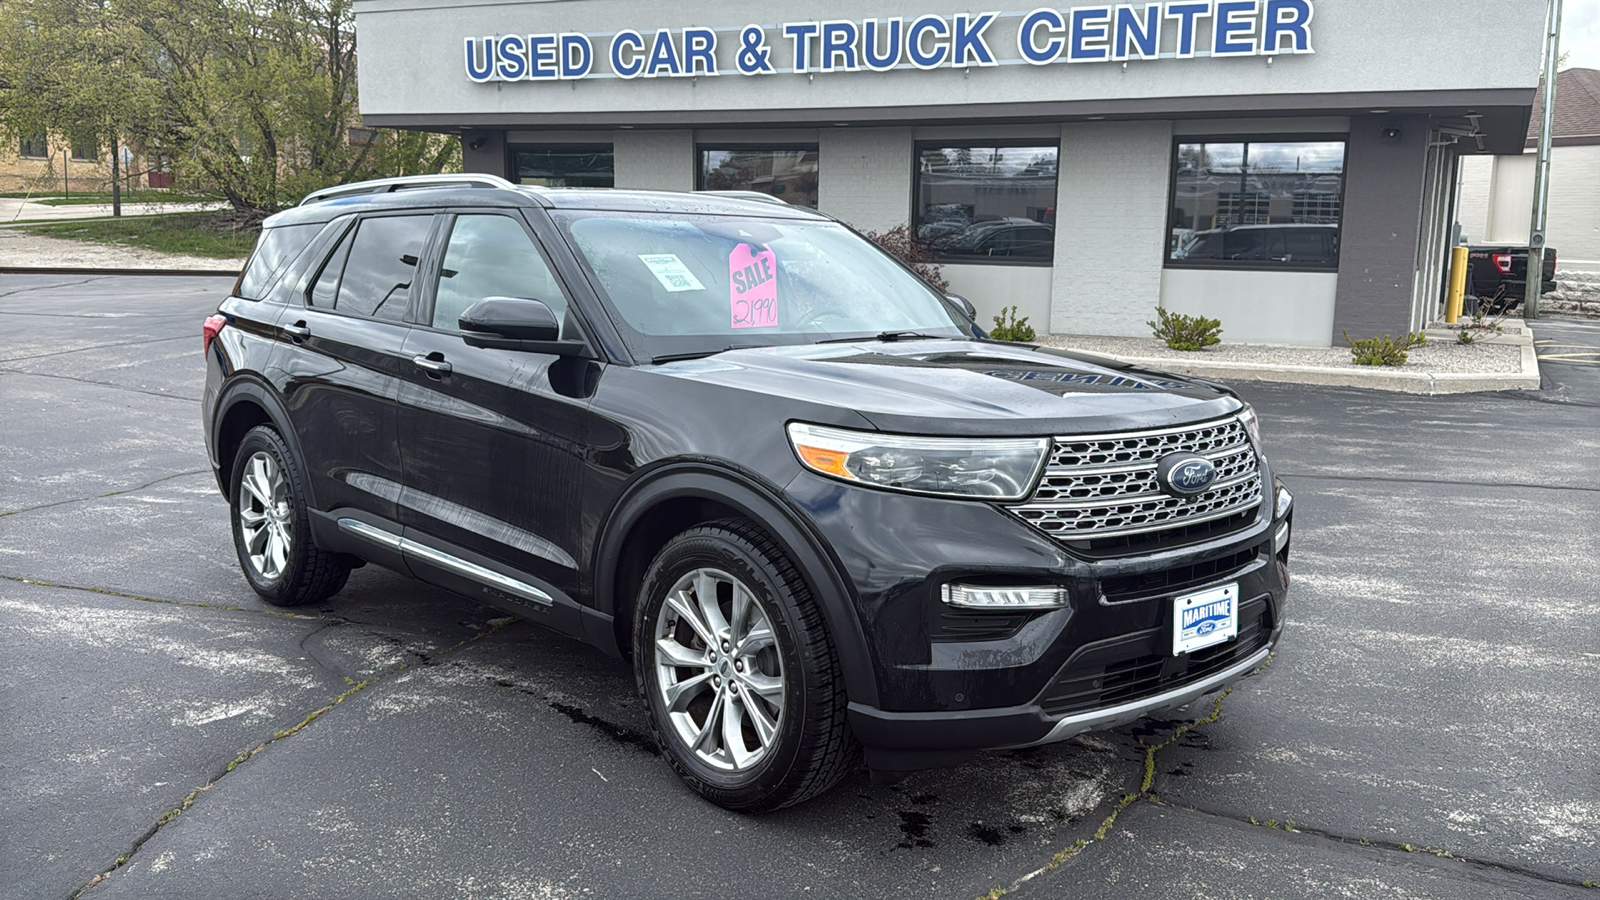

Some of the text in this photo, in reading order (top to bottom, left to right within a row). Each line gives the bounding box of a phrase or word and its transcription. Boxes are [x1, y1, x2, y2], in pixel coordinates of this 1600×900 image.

[464, 0, 1316, 84] USED CAR & TRUCK CENTER
[732, 257, 774, 294] SALE
[1182, 465, 1209, 486] Ford
[1184, 600, 1230, 628] MARITIME
[1199, 623, 1214, 634] Ford
